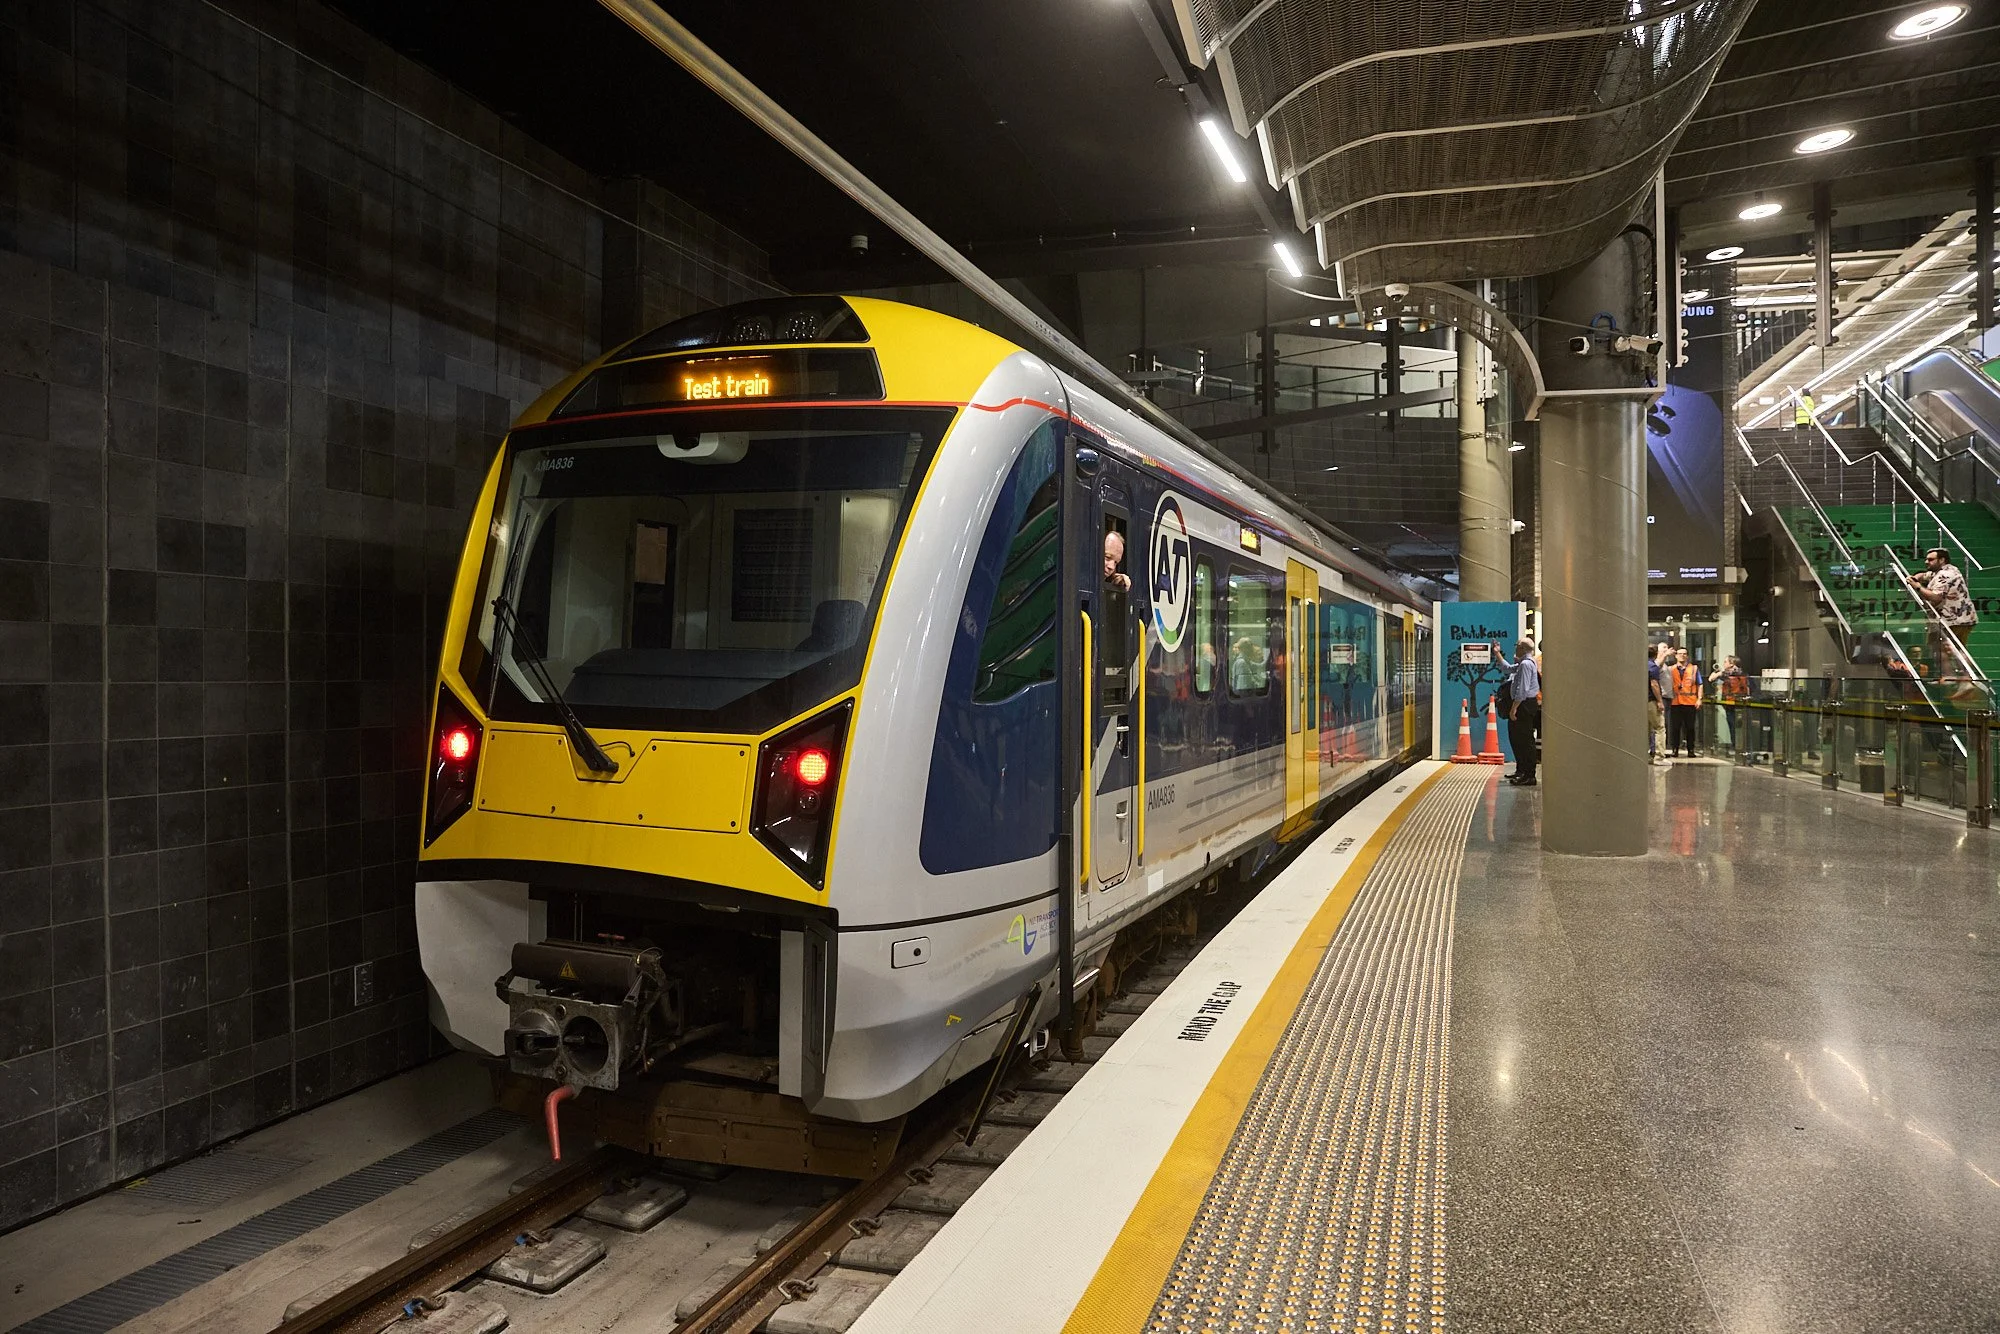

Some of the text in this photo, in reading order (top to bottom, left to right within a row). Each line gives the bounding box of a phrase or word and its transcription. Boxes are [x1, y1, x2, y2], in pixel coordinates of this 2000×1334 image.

[1680, 305, 1715, 317] SUNG
[684, 373, 769, 400] Test train
[533, 456, 575, 472] AMA836
[1153, 534, 1189, 605] AT
[1147, 783, 1175, 812] AMA836
[1177, 981, 1242, 1042] MIND THE GAP
